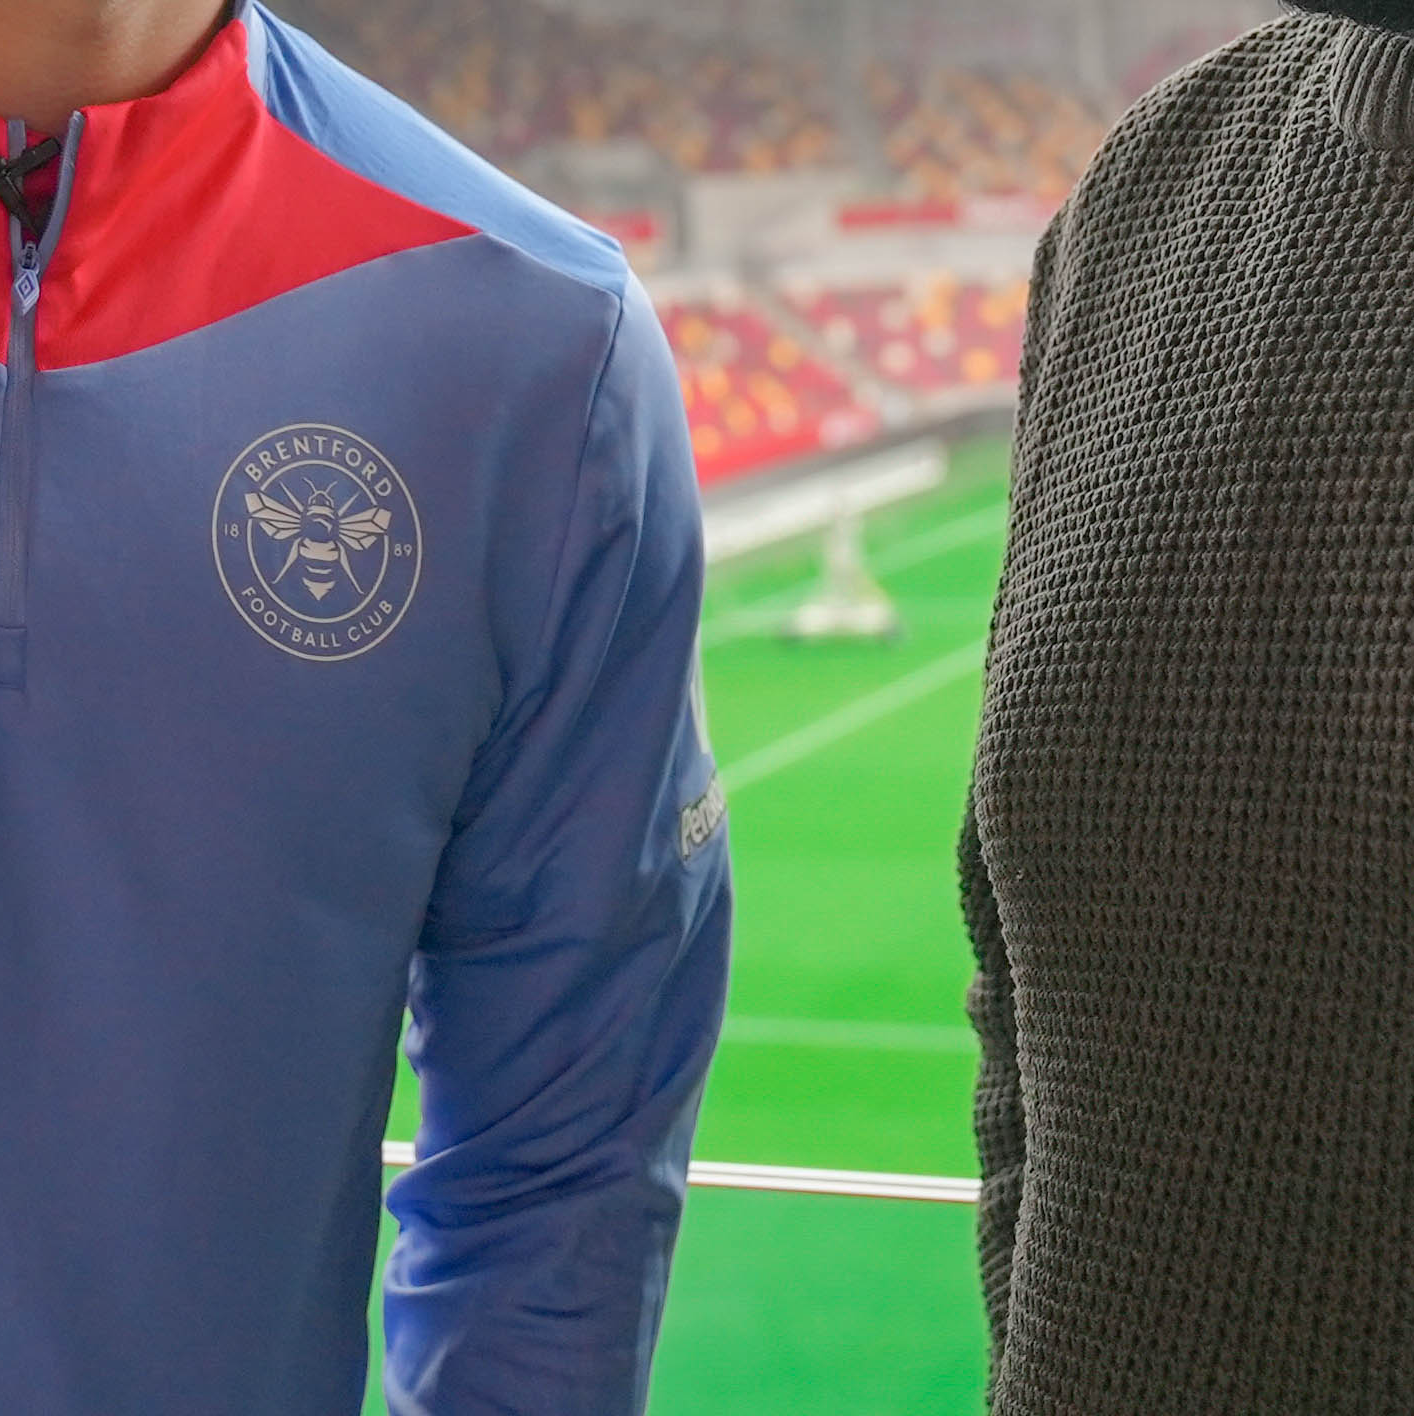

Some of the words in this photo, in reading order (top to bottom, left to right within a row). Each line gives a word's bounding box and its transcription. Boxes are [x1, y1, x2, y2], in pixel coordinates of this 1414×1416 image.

[244, 435, 392, 497] BRENTFORD
[224, 524, 239, 537] 18
[394, 544, 412, 557] 89
[242, 586, 341, 648] FOOTBALL
[347, 600, 393, 642] CLUB
